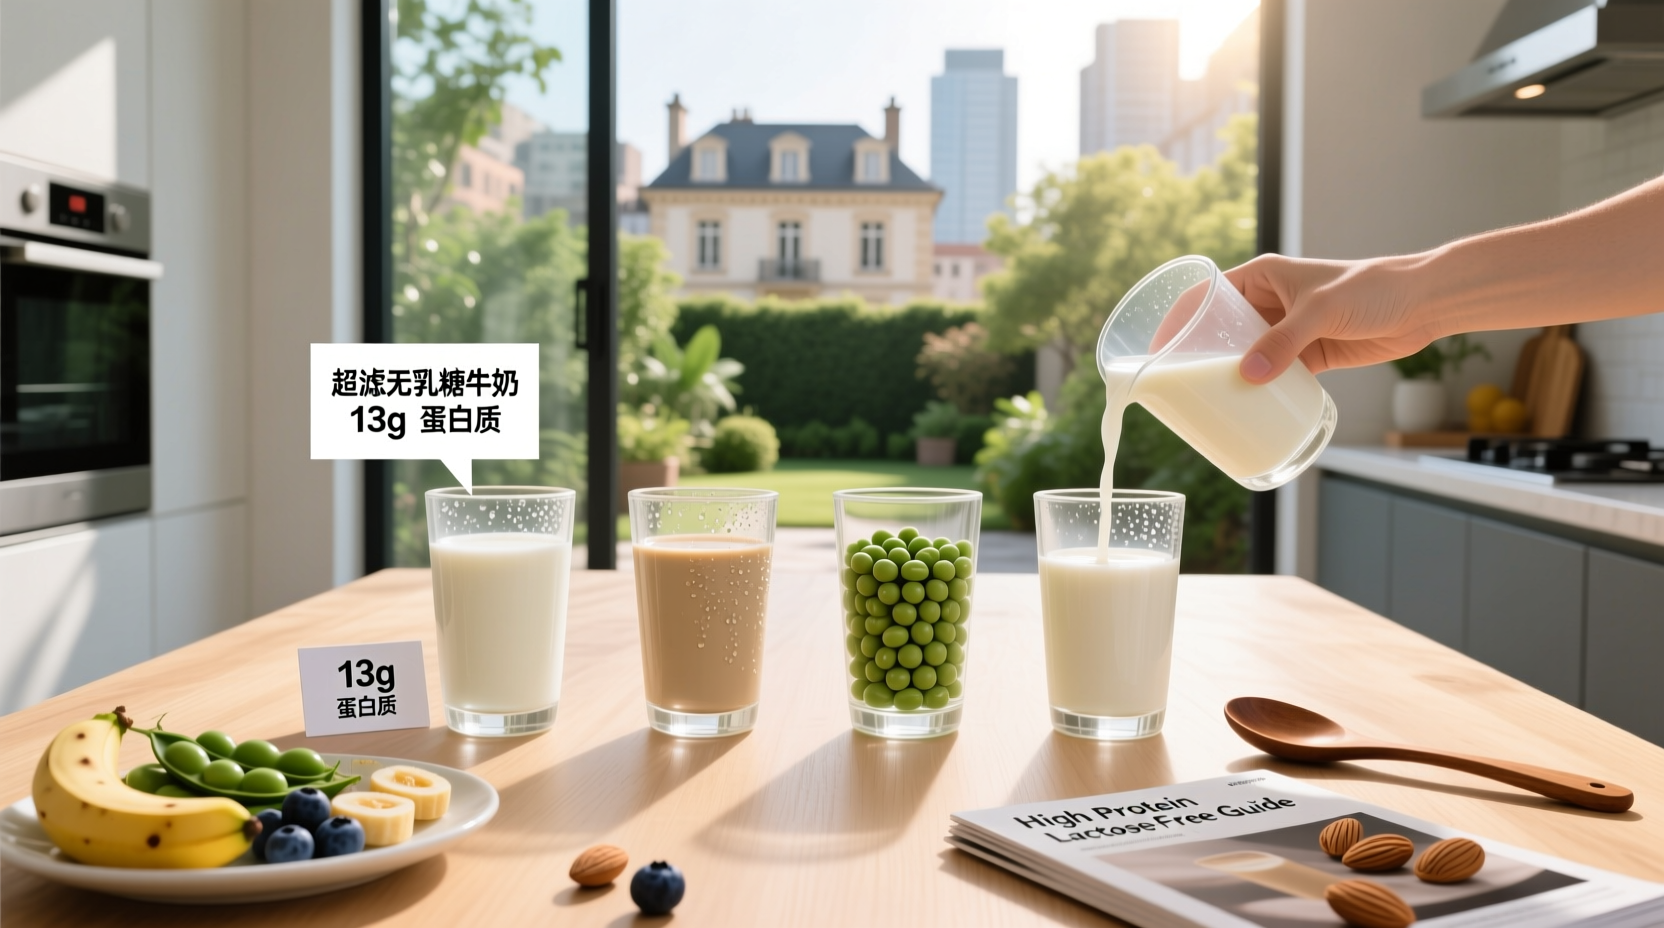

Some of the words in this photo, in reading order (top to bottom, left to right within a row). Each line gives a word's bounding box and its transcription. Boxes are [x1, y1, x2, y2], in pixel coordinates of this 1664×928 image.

[337, 658, 396, 694] 13g
[336, 694, 397, 719] 蛋白质
[1012, 810, 1094, 829] High
[1091, 797, 1199, 820] Protein
[1217, 797, 1297, 817] Guide
